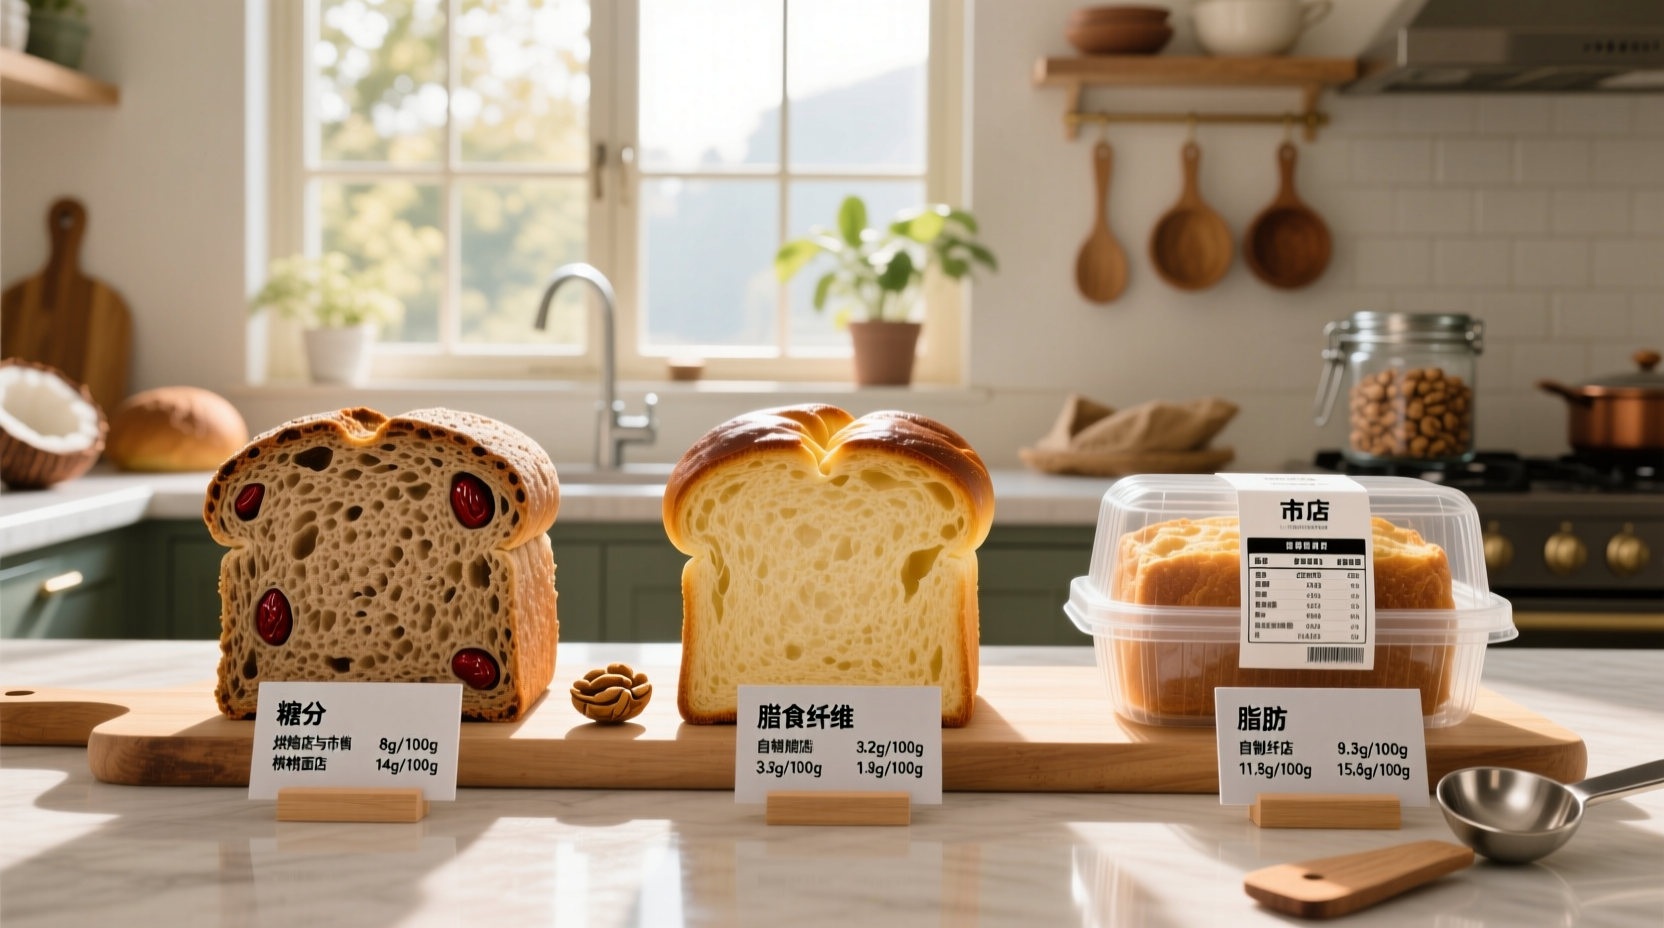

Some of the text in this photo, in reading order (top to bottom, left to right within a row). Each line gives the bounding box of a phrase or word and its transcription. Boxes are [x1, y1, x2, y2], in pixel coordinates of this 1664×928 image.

[1280, 499, 1329, 522] 市店
[1238, 705, 1288, 731] 脂肪
[379, 737, 438, 754] 8g/100g
[856, 741, 924, 757] 3.2g/100g
[1338, 742, 1408, 759] 9.3g/100g
[376, 758, 438, 775] 14g/100g
[857, 761, 923, 778] 1.9g/100g
